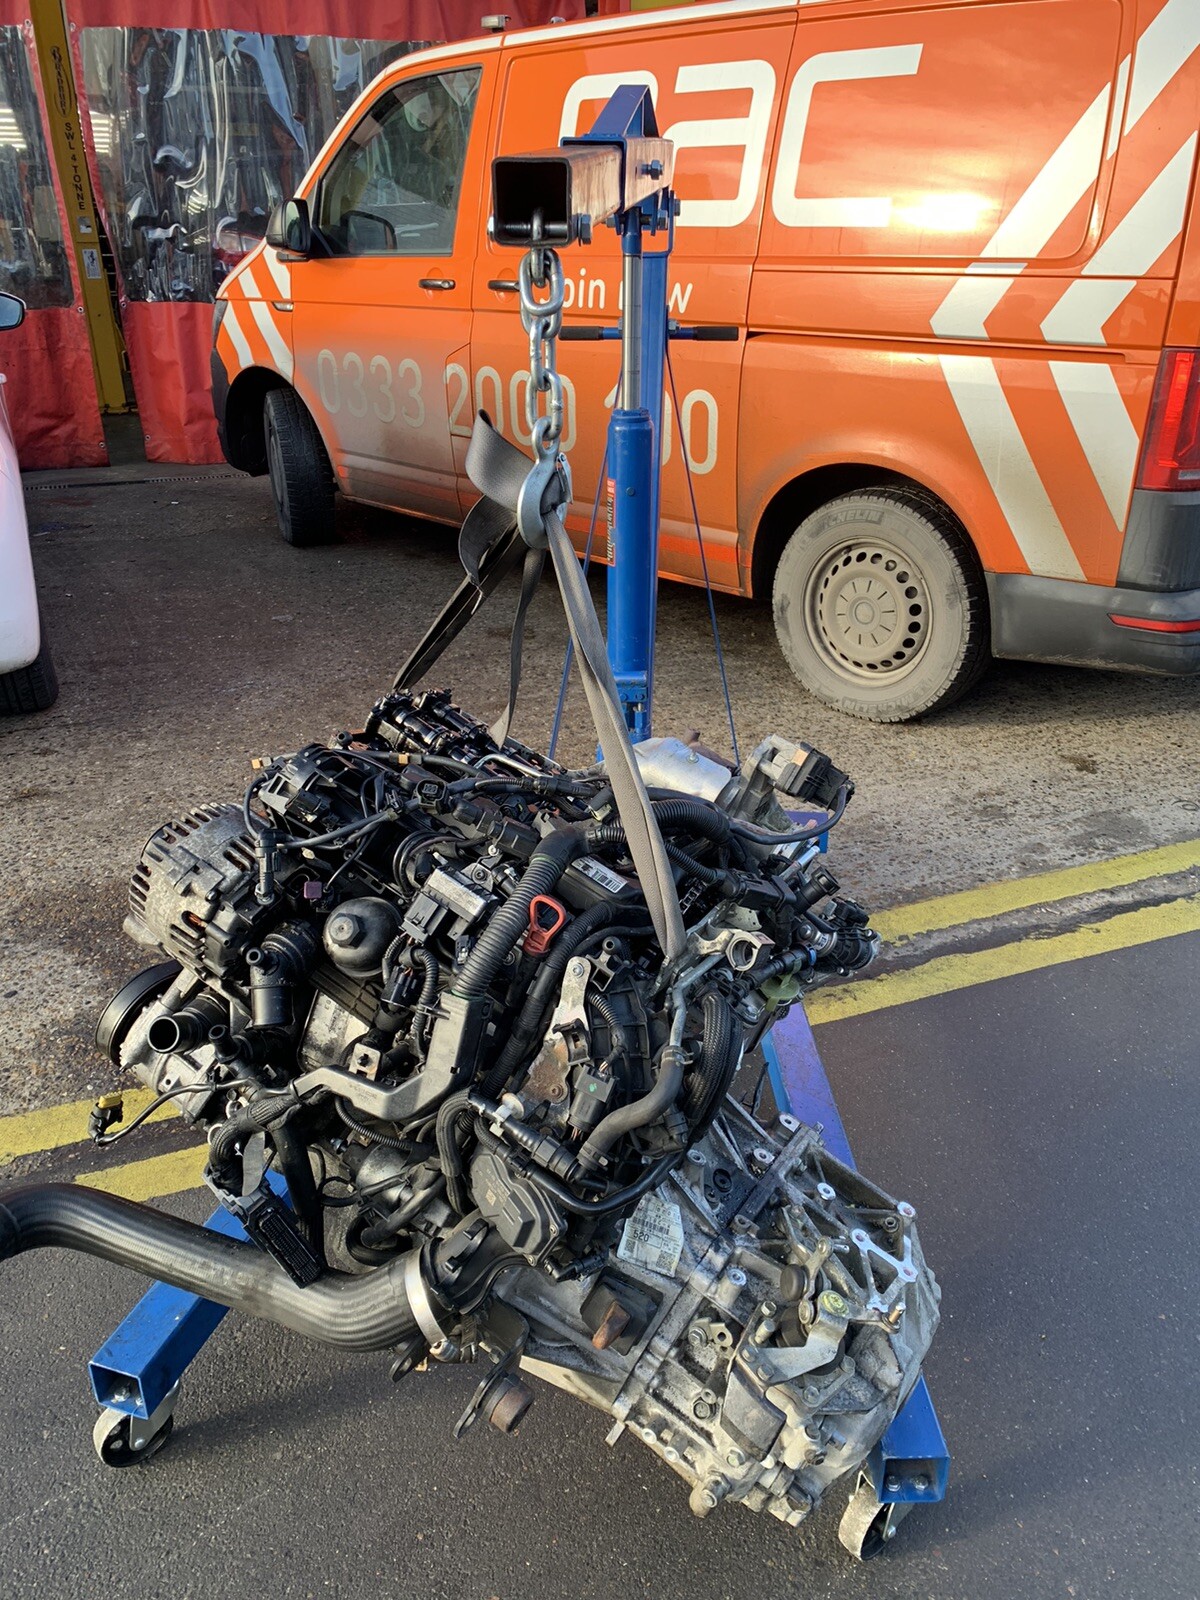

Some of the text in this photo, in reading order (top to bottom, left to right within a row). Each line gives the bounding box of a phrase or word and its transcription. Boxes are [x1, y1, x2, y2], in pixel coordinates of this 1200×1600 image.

[64, 122, 75, 150] SWL
[72, 165, 86, 210] TONNE
[539, 267, 606, 310] oin
[317, 349, 425, 428] 0333
[633, 1229, 650, 1243] 520
